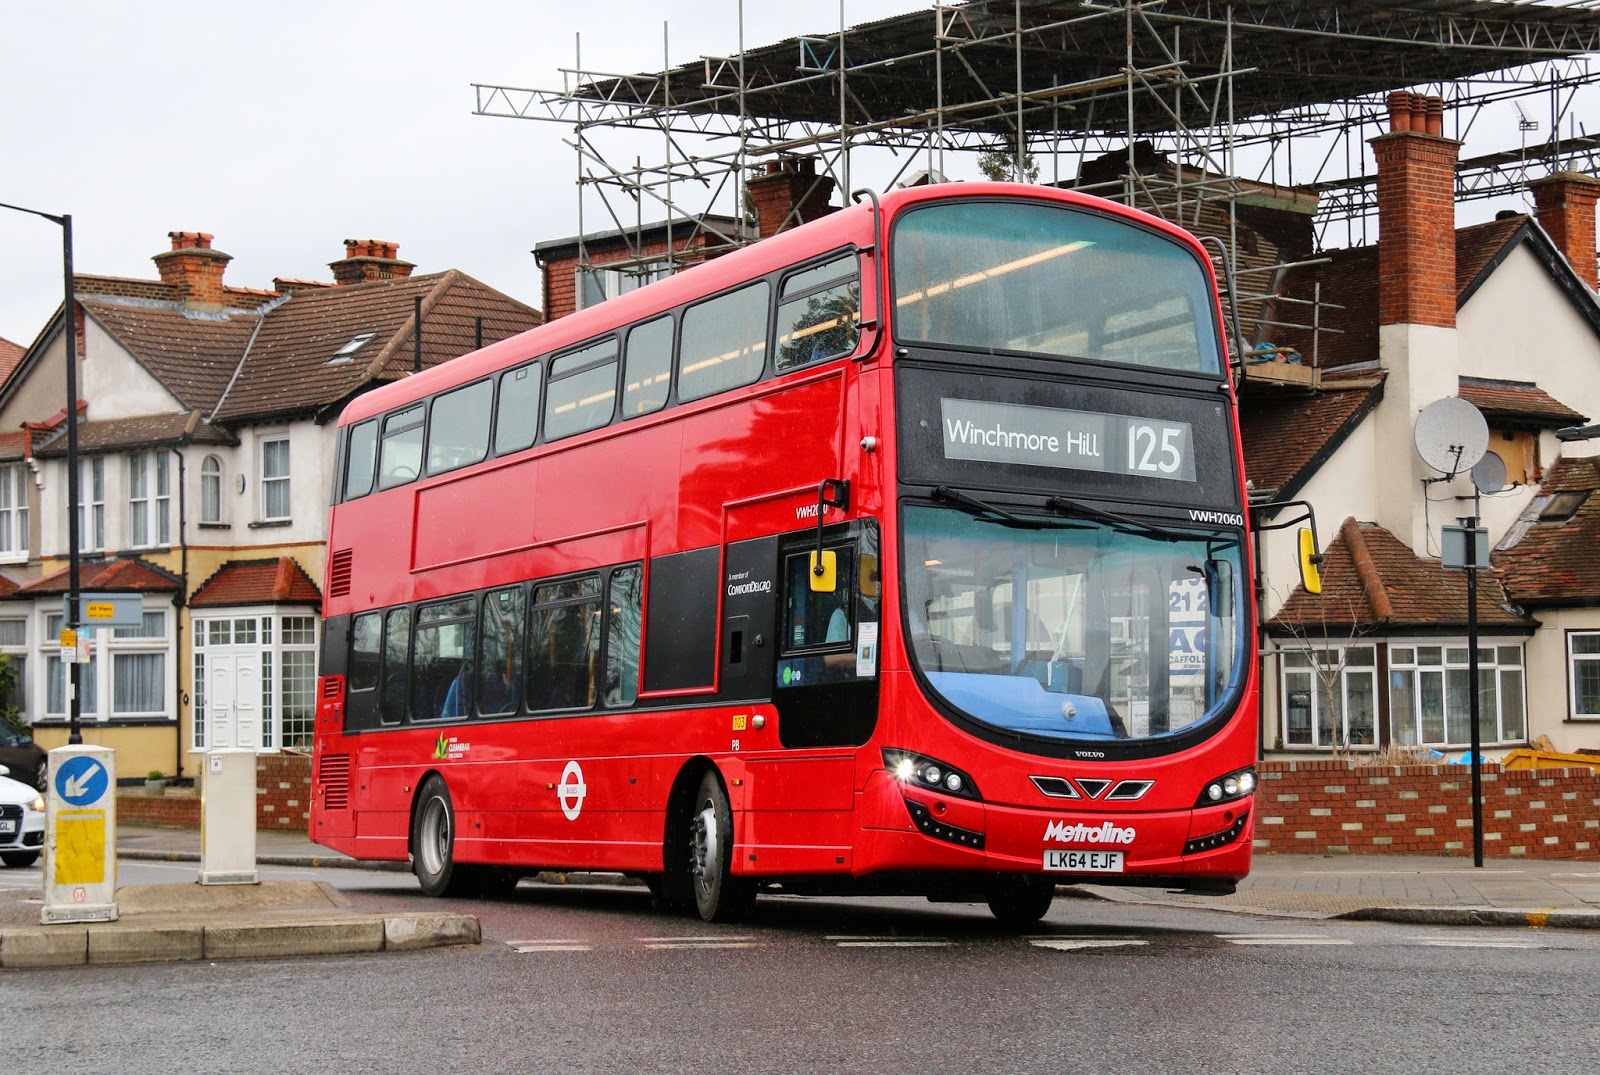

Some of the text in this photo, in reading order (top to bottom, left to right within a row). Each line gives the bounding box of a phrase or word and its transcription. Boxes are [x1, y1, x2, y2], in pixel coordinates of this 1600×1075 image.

[946, 418, 1100, 457] Winchmore Hill
[1128, 424, 1181, 473] 125
[795, 503, 828, 520] VWH200
[1188, 509, 1243, 526] VWH2060
[734, 716, 745, 729] 103
[731, 739, 740, 751] PB
[566, 787, 578, 795] BUSES
[1043, 820, 1136, 844] Metroline
[1049, 852, 1117, 869] LK64 EJF
